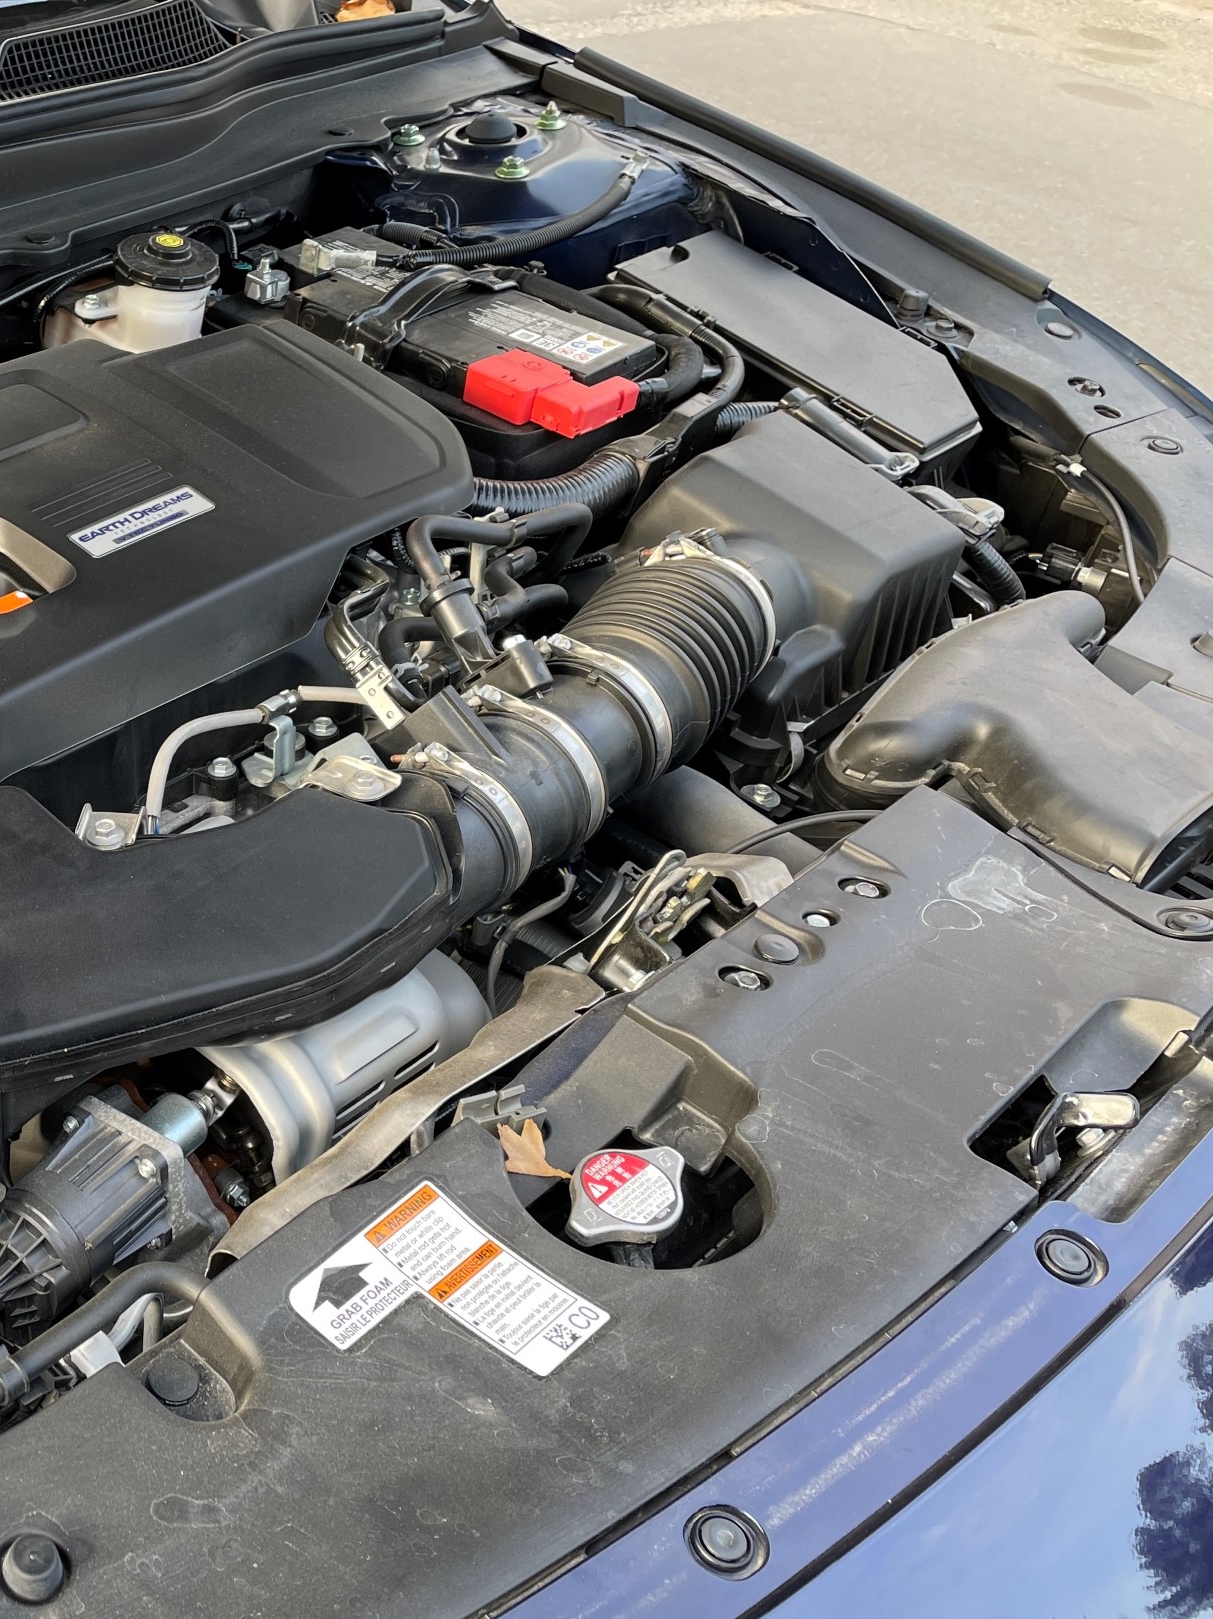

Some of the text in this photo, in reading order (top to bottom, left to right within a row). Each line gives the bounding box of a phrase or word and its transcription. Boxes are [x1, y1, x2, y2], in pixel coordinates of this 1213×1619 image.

[78, 491, 193, 543] EARTH DREAMS
[585, 1154, 612, 1176] DANGER
[382, 1190, 433, 1231] WARNING
[385, 1209, 436, 1251] Do not touch bare
[394, 1216, 444, 1258] metal or white clip
[400, 1222, 452, 1265] Metal rod gets hot
[409, 1259, 423, 1272] and
[421, 1251, 434, 1262] can
[430, 1240, 447, 1254] burn
[417, 1259, 440, 1279] Always
[444, 1243, 457, 1256] rod
[425, 1269, 445, 1285] using
[439, 1257, 458, 1272] foam
[442, 1244, 498, 1291] AVERTISSEMENT
[330, 1276, 393, 1330] GRAB FOAM
[334, 1279, 414, 1345] SAISIR LE PROTECTEUR
